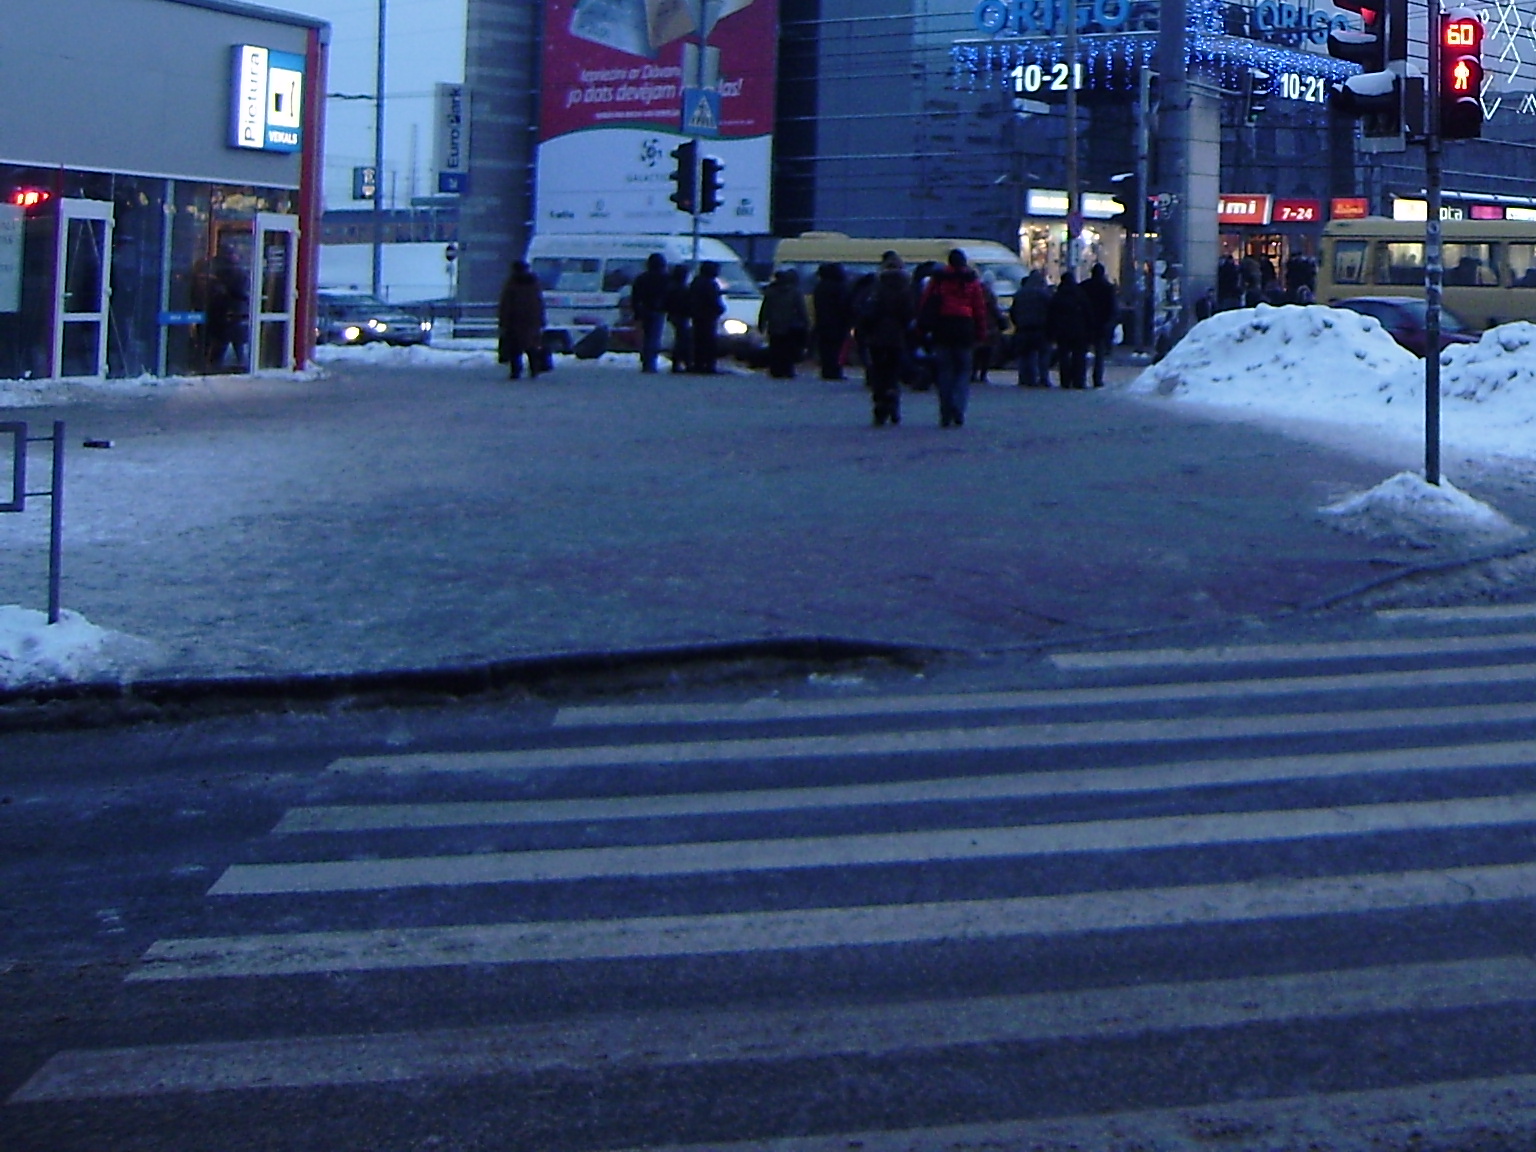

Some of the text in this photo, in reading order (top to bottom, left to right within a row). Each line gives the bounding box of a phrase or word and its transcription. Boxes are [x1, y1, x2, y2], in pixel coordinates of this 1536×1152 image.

[1447, 23, 1474, 46] 60
[1011, 62, 1083, 92] 10-21
[1280, 72, 1326, 103] 10-21
[1217, 199, 1256, 214] imi
[1282, 207, 1313, 221] 7-24
